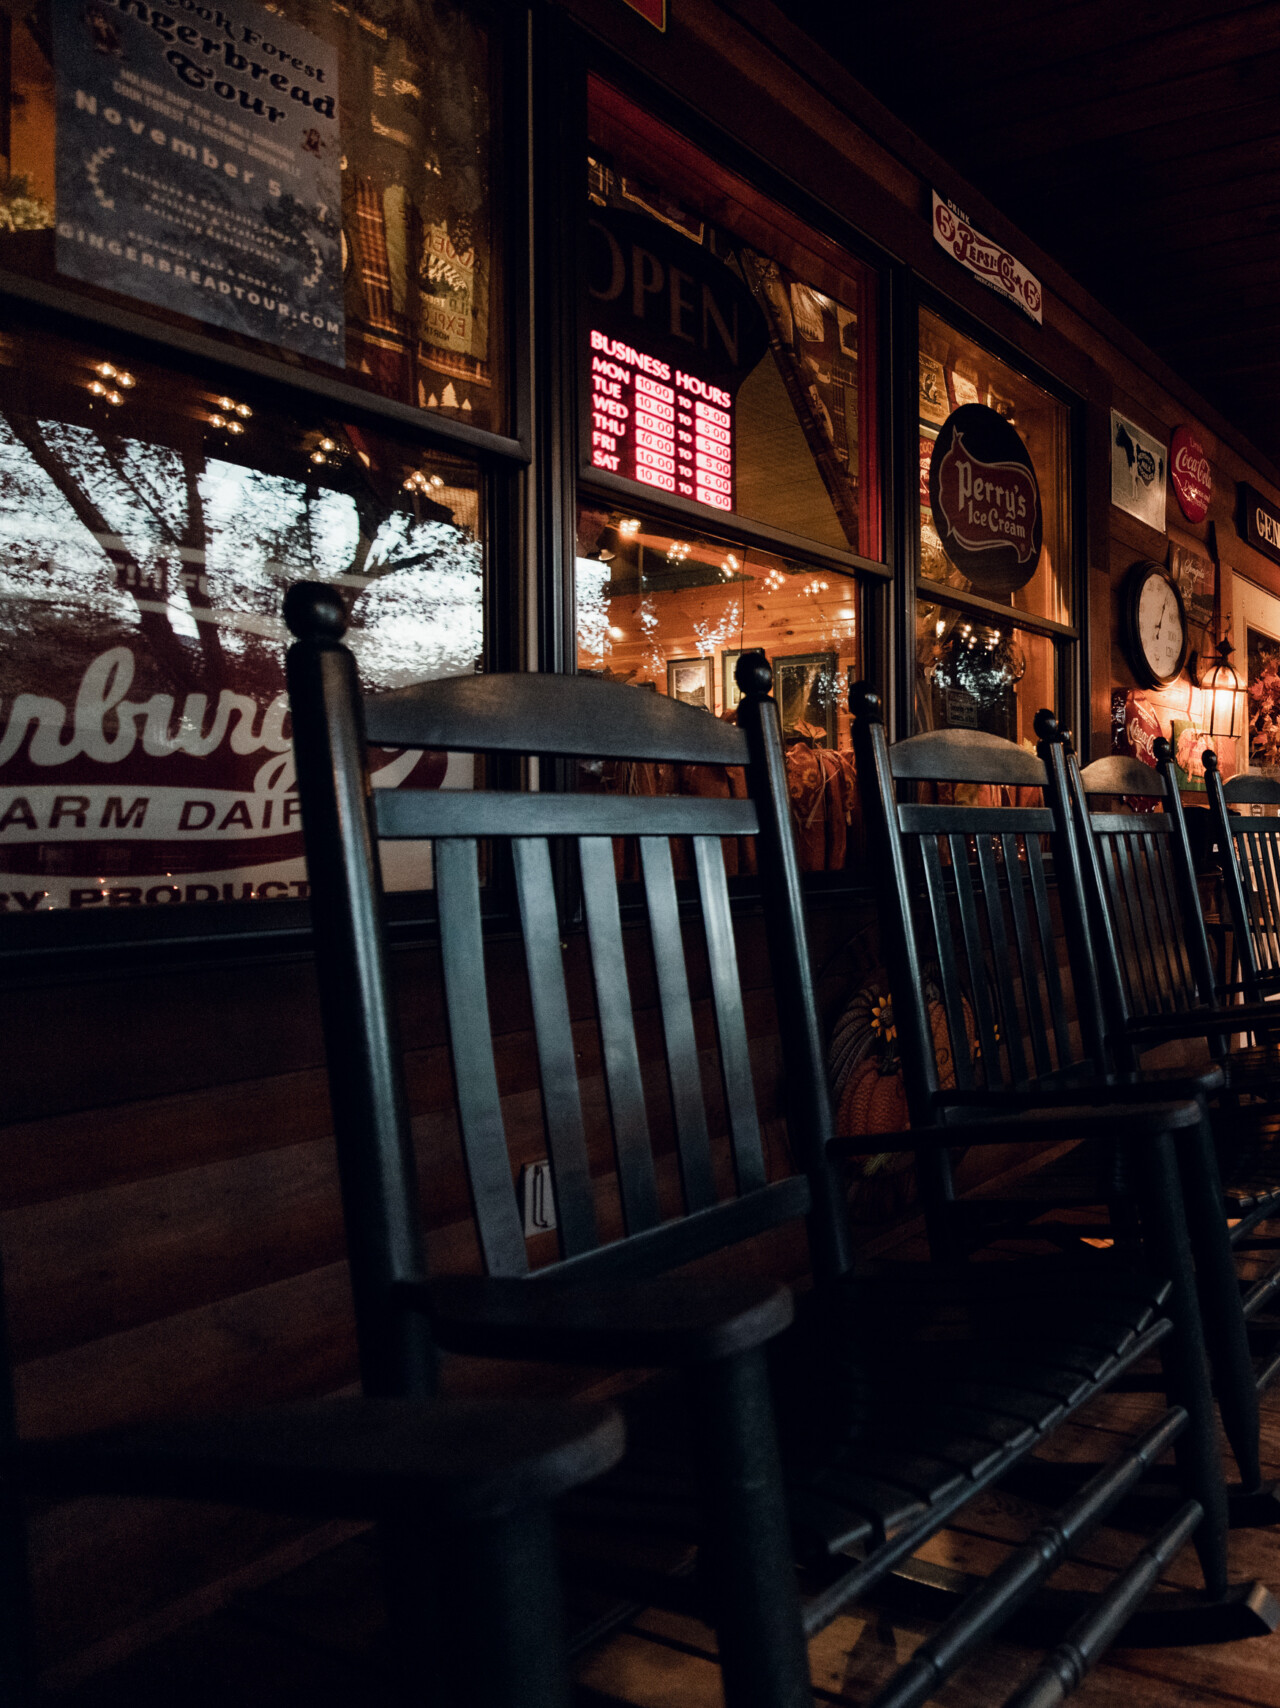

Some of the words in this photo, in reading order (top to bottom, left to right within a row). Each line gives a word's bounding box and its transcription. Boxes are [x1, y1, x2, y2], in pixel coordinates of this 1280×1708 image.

[108, 0, 336, 120] ngerbread
[242, 25, 327, 83] Forest
[166, 50, 286, 123] Tour
[75, 89, 256, 185] November
[268, 178, 282, 199] 5
[317, 201, 329, 222] 7
[947, 198, 971, 225] DRINK
[57, 221, 340, 335] GINGERBREADTOUR.COM
[590, 330, 671, 381] BUSINESS
[676, 370, 731, 408] HOURS
[592, 356, 630, 385] MON
[592, 374, 621, 399] TUE
[592, 393, 629, 419] WED
[592, 412, 625, 436] THU
[593, 430, 616, 452] FRI
[593, 450, 620, 471] SAT
[955, 460, 1026, 520] Perry's
[0, 796, 150, 832] ARM
[68, 880, 310, 910] PRODUCT
